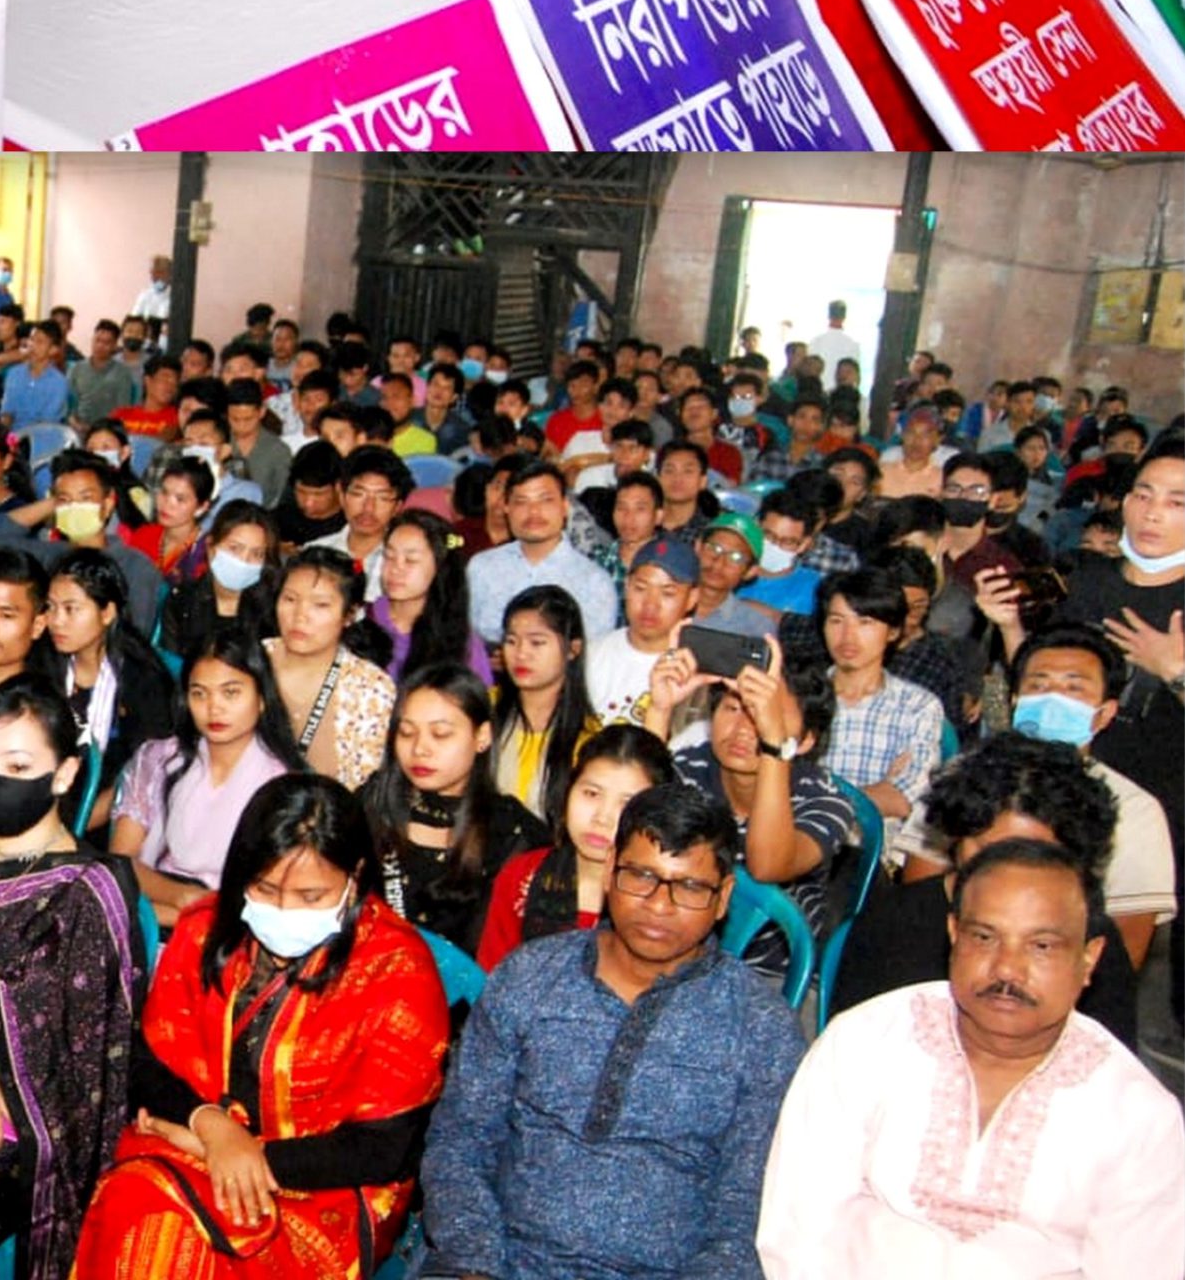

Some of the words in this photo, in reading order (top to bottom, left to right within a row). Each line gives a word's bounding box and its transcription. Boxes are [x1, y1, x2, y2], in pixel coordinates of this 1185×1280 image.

[737, 40, 843, 149] পাহাড়ে
[970, 21, 1056, 114] অস্থায়ী
[1036, 5, 1099, 78] সেনা
